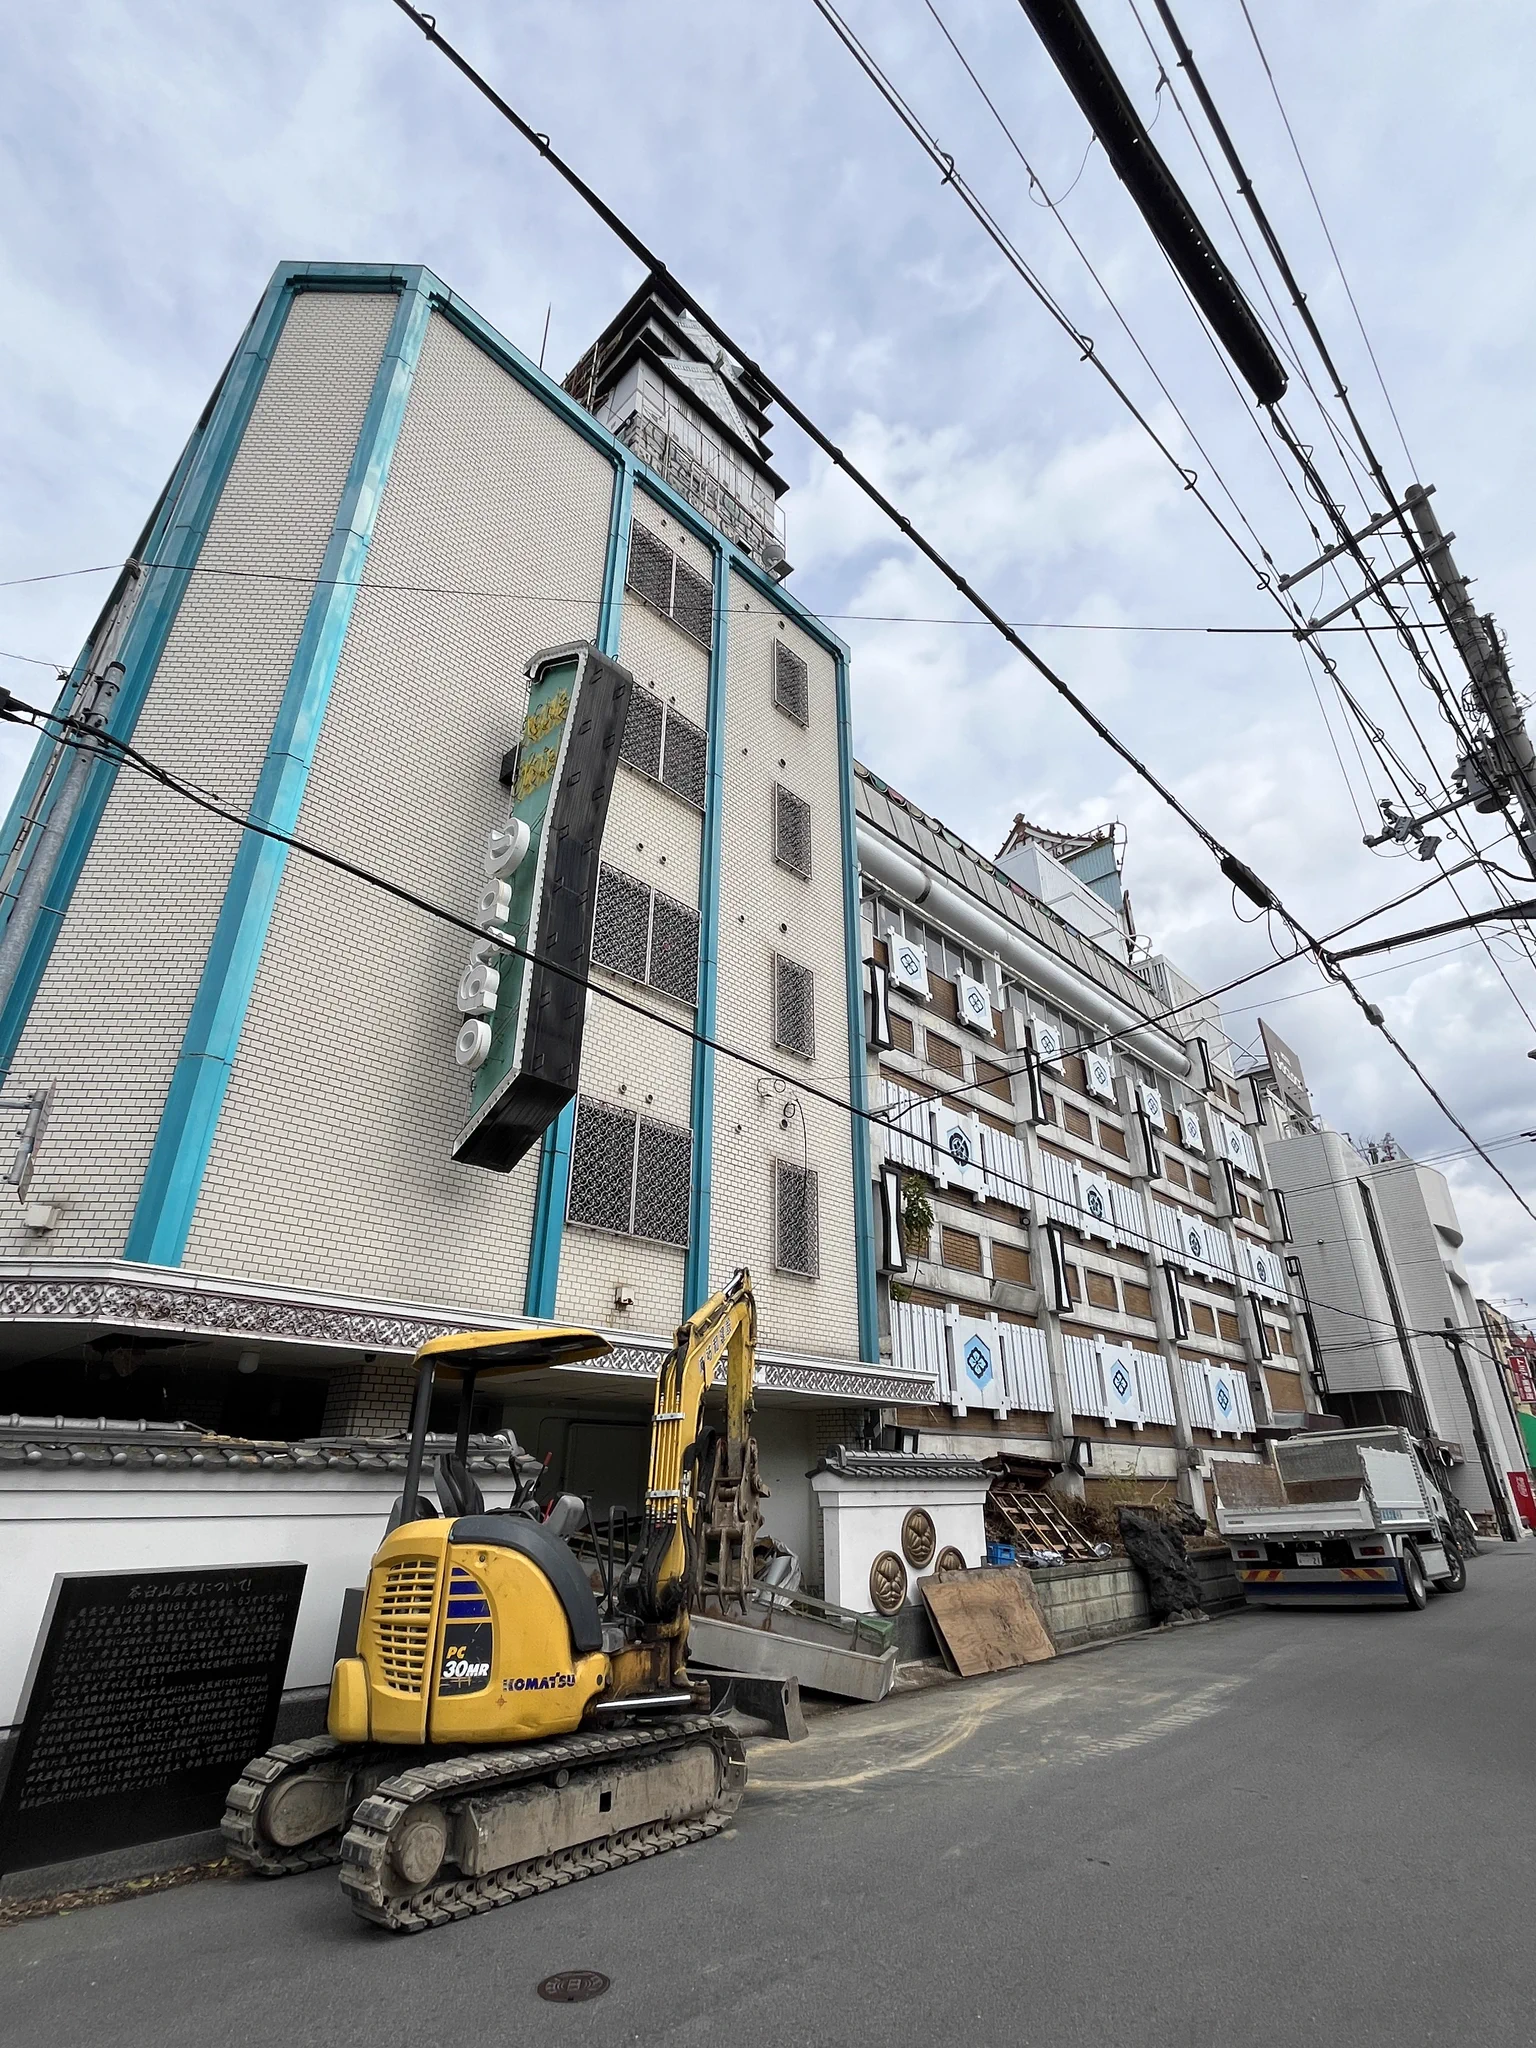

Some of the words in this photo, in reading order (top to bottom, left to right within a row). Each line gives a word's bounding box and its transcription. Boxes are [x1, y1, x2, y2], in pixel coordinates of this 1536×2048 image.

[446, 1645, 467, 1660] PC
[442, 1660, 490, 1678] 30MR
[503, 1671, 576, 1692] KOMATSU
